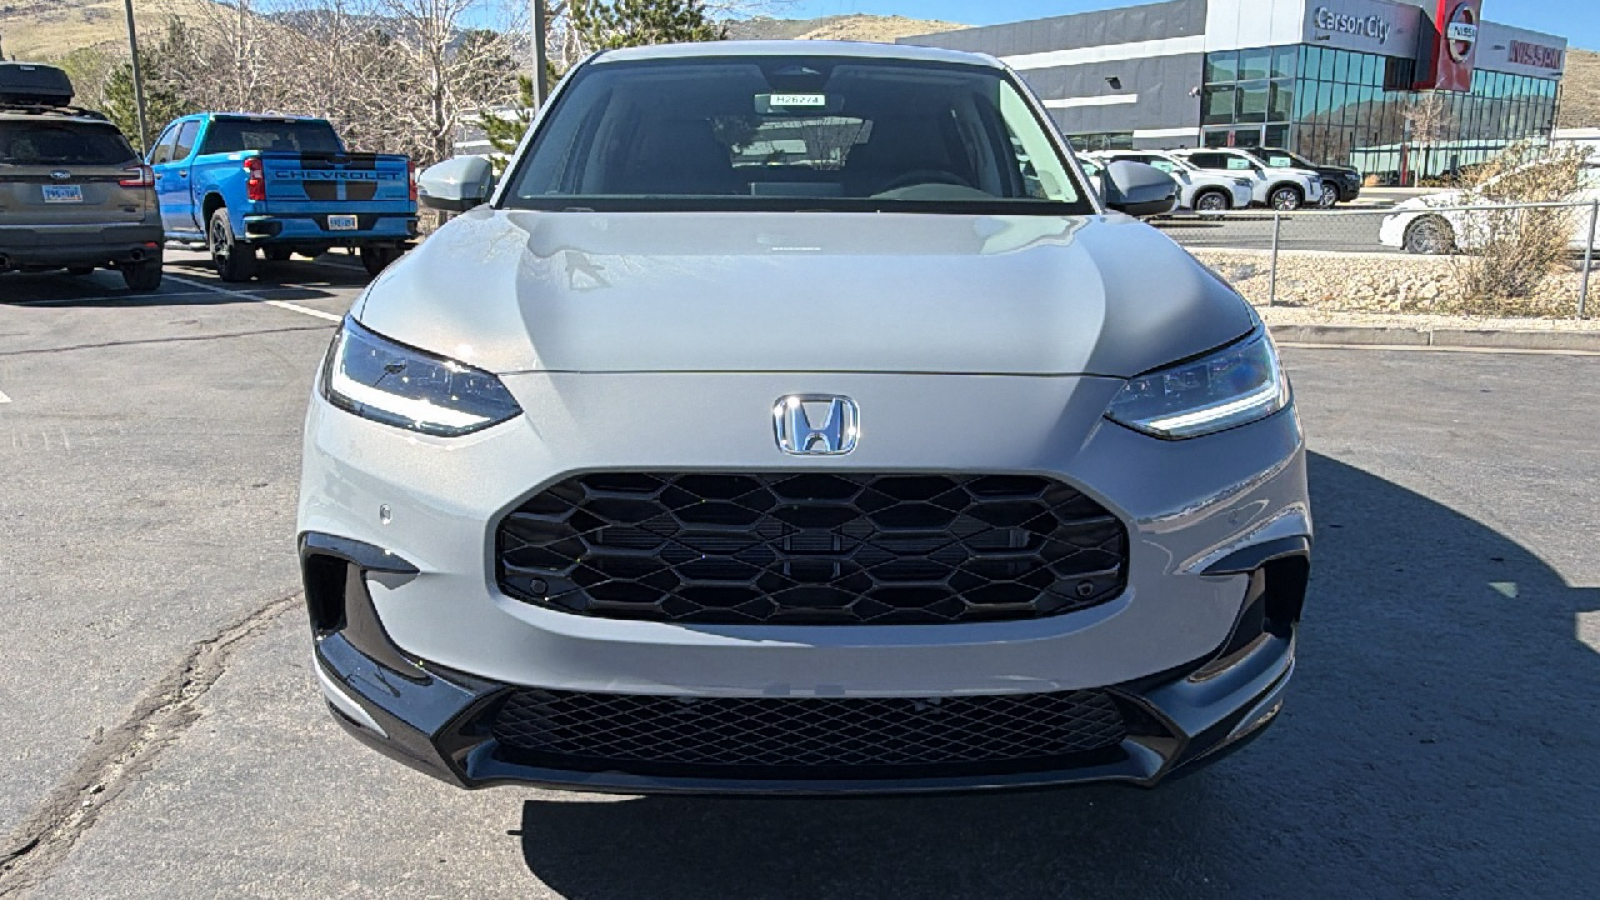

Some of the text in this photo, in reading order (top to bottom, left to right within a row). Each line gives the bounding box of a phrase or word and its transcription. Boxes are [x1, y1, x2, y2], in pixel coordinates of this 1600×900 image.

[1316, 6, 1391, 45] Carson City
[1508, 40, 1561, 69] NISSAN
[275, 169, 400, 180] CHEVROLET
